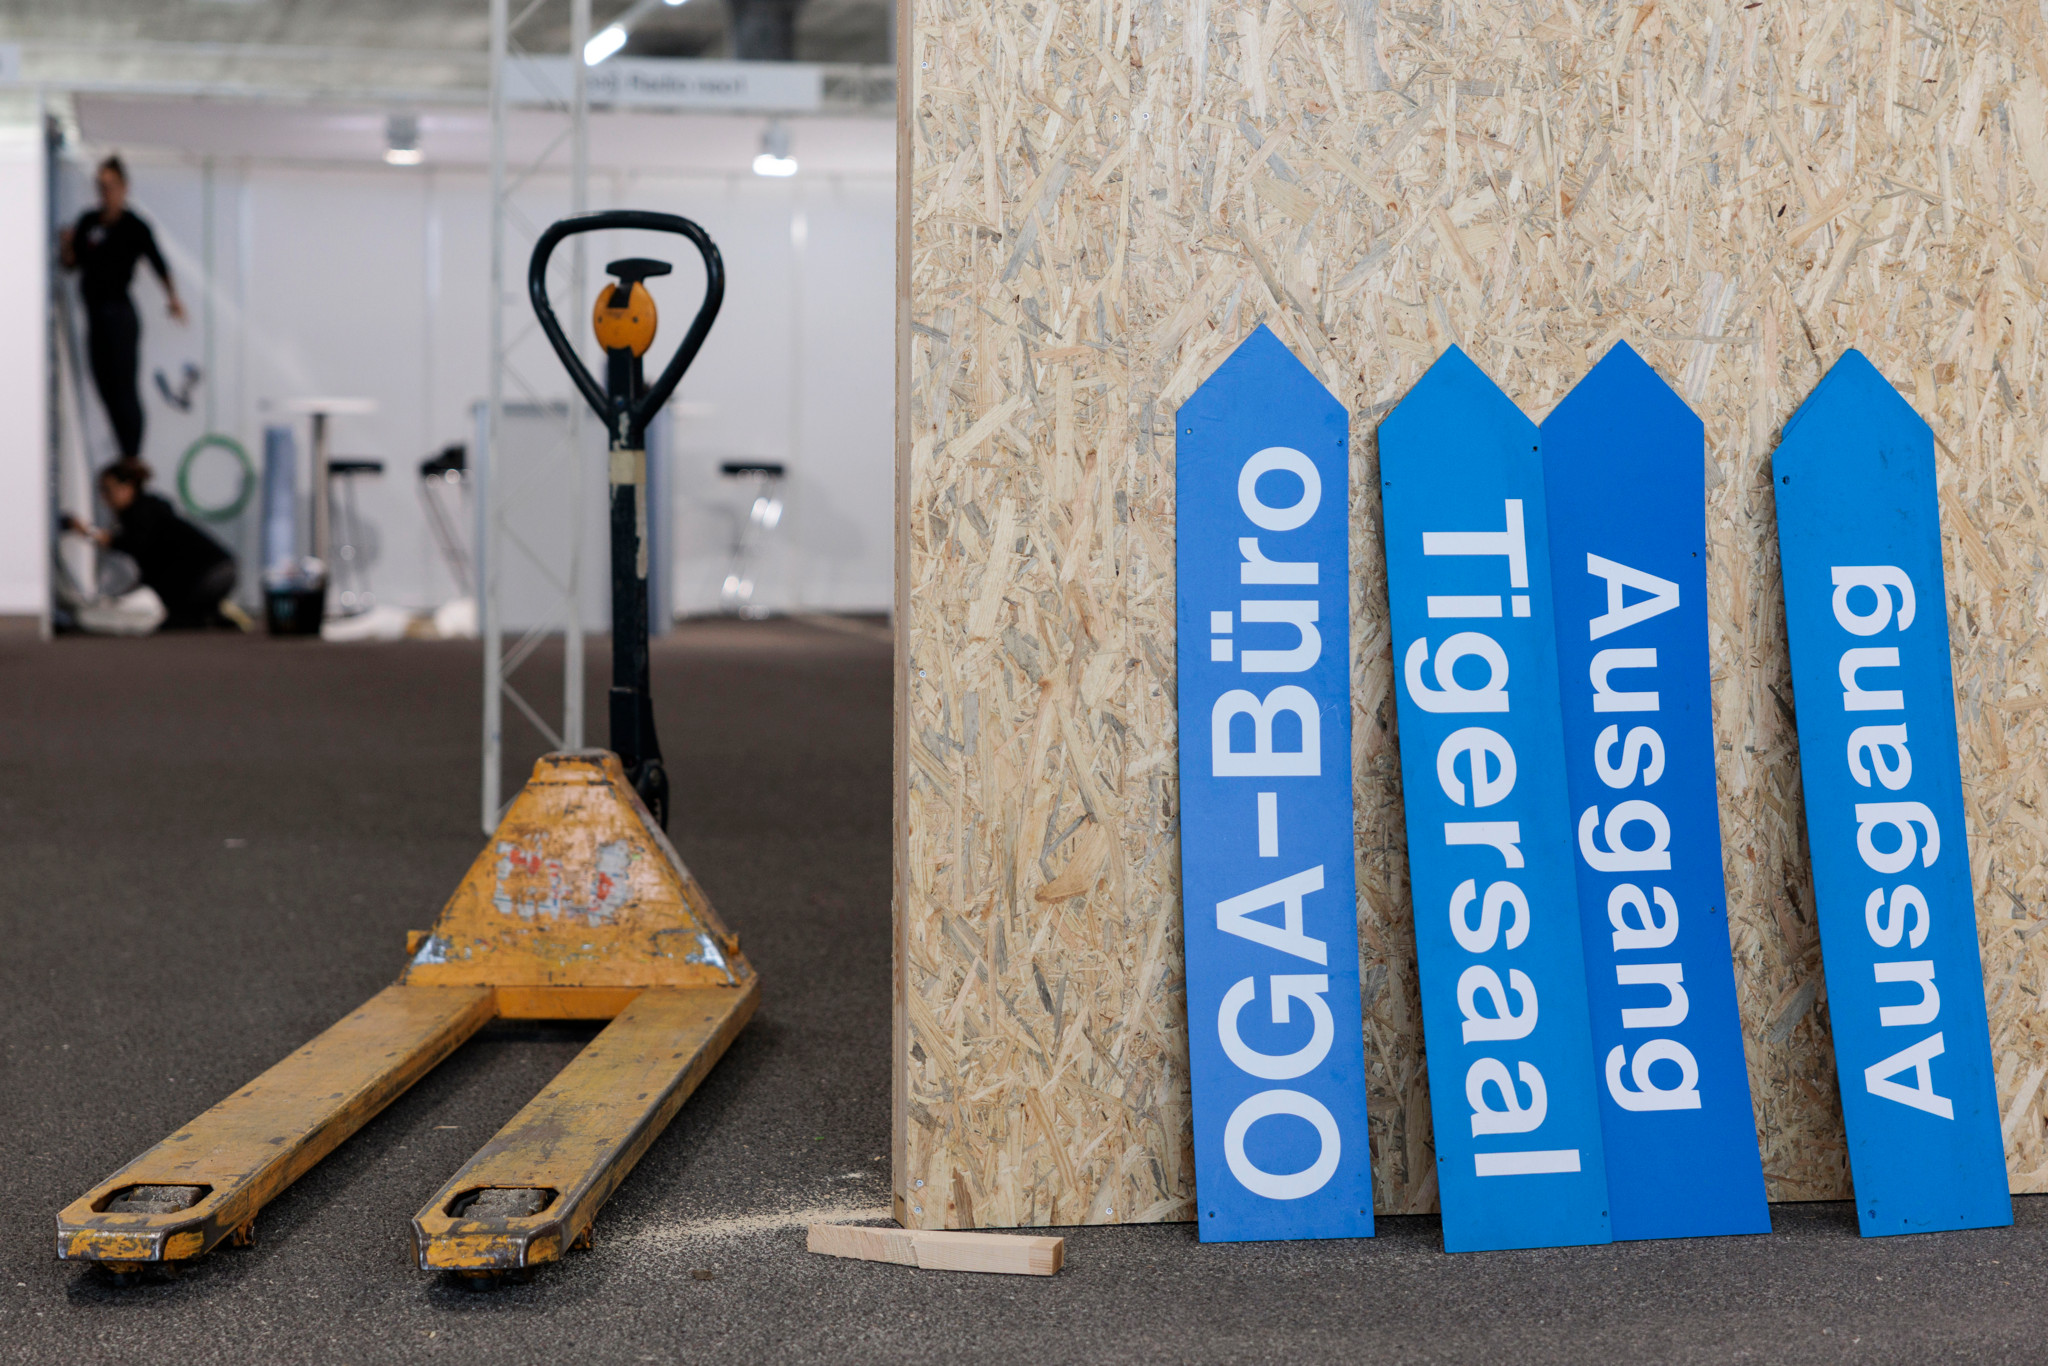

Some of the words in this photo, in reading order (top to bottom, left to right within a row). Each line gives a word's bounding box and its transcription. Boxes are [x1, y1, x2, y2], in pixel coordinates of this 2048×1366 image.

[1211, 446, 1341, 1200] OGA-Büro
[1405, 499, 1582, 1178] Tigersaal
[1578, 552, 1703, 1112] Ausgang
[1831, 566, 1955, 1121] Ausgang
